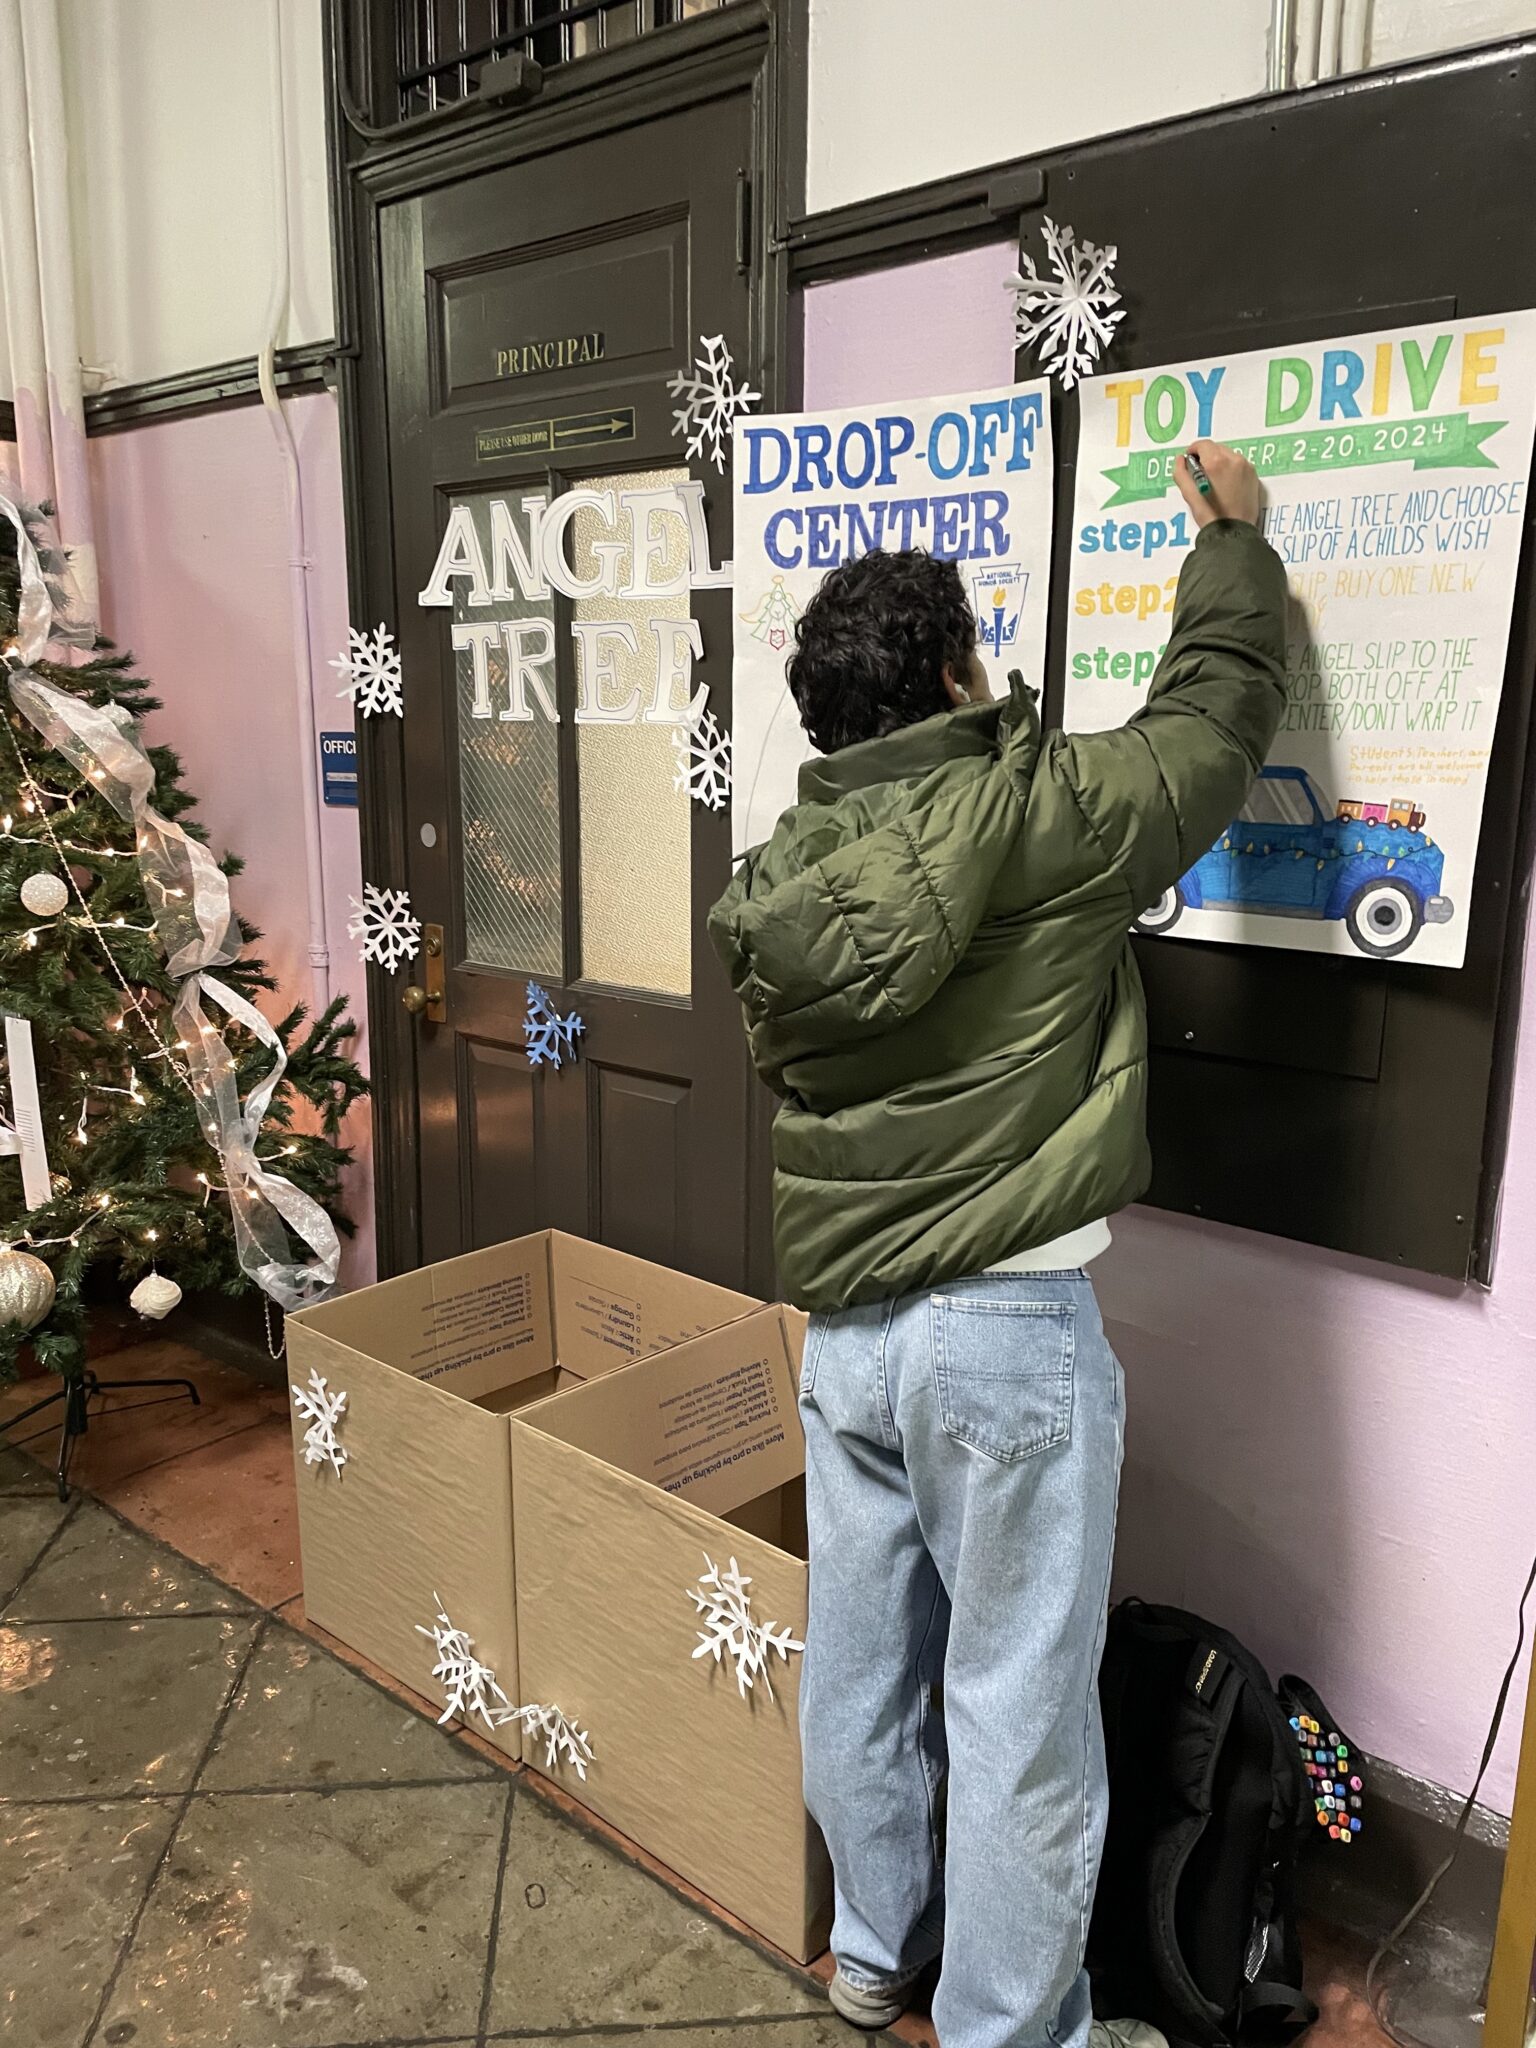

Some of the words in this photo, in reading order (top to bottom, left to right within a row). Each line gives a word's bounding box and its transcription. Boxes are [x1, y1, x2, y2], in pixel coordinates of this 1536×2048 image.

[496, 333, 604, 376] PRINCIPAL
[1105, 367, 1227, 448] TOY
[1265, 328, 1505, 428] DRIVE
[743, 392, 1043, 494] DROP-OFF
[1147, 443, 1276, 479] DEER
[1374, 421, 1448, 452] 2024
[1262, 504, 1291, 535] THE
[1291, 499, 1343, 533] ANGEL
[1351, 493, 1399, 527] TREE
[1400, 489, 1437, 525] AND
[1440, 481, 1525, 520] CHOOSE
[418, 480, 734, 606] ANGEL
[764, 491, 1010, 569] CENTER
[1079, 512, 1191, 558] step1
[1282, 532, 1318, 564] SLIP
[1319, 531, 1343, 561] OF
[1345, 529, 1358, 560] A
[1363, 525, 1425, 558] CHILDS
[1436, 519, 1492, 551] WISH
[1335, 569, 1376, 599] BUY
[1379, 565, 1425, 597] ONE
[1428, 561, 1485, 593] NEW
[451, 617, 710, 724] TREE
[1072, 645, 1167, 686] step
[1300, 642, 1358, 672] ANGEL
[1364, 641, 1406, 669] SLIP
[1412, 640, 1437, 668] TO
[1442, 638, 1478, 669] THE
[1286, 672, 1322, 701] ROP
[1328, 671, 1379, 700] BOTH
[1385, 670, 1433, 700] OFF
[1434, 670, 1463, 700] AT
[1406, 701, 1458, 731] WRAP
[1461, 701, 1482, 731] IT
[324, 740, 356, 754] OFFIC
[732, 1449, 745, 1460] pro
[752, 1442, 765, 1451] like
[766, 1432, 784, 1445] Move
[682, 1476, 692, 1484] up
[693, 1460, 721, 1479] picking
[723, 1457, 732, 1466] by
